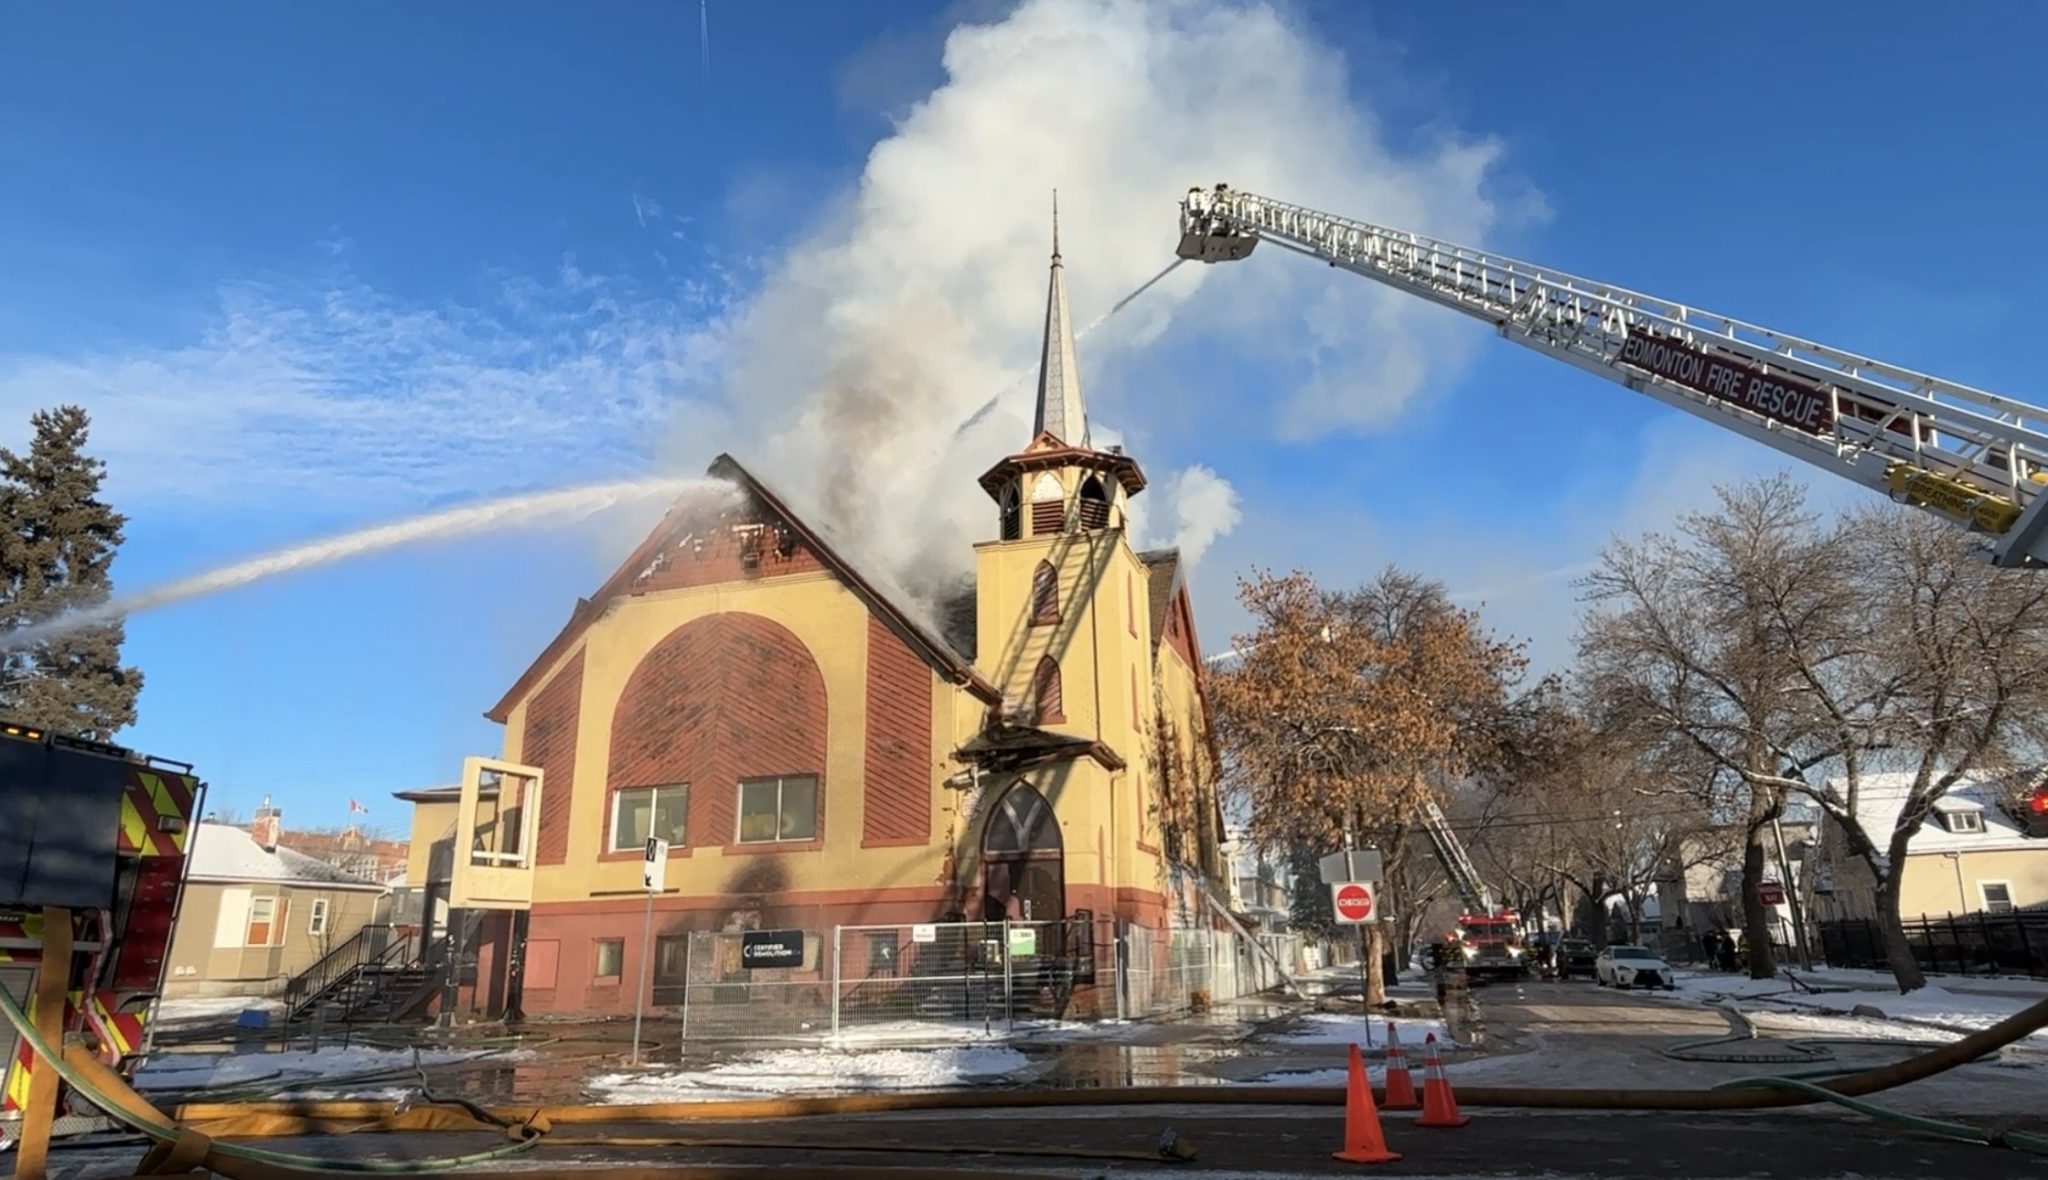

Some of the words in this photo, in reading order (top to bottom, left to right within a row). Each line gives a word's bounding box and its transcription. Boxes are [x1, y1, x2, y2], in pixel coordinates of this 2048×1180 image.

[1624, 335, 1705, 384] EDMONTON
[1706, 364, 1744, 398] FIRE
[1745, 378, 1824, 427] RESCUE
[1911, 482, 1968, 512] BREATHING
